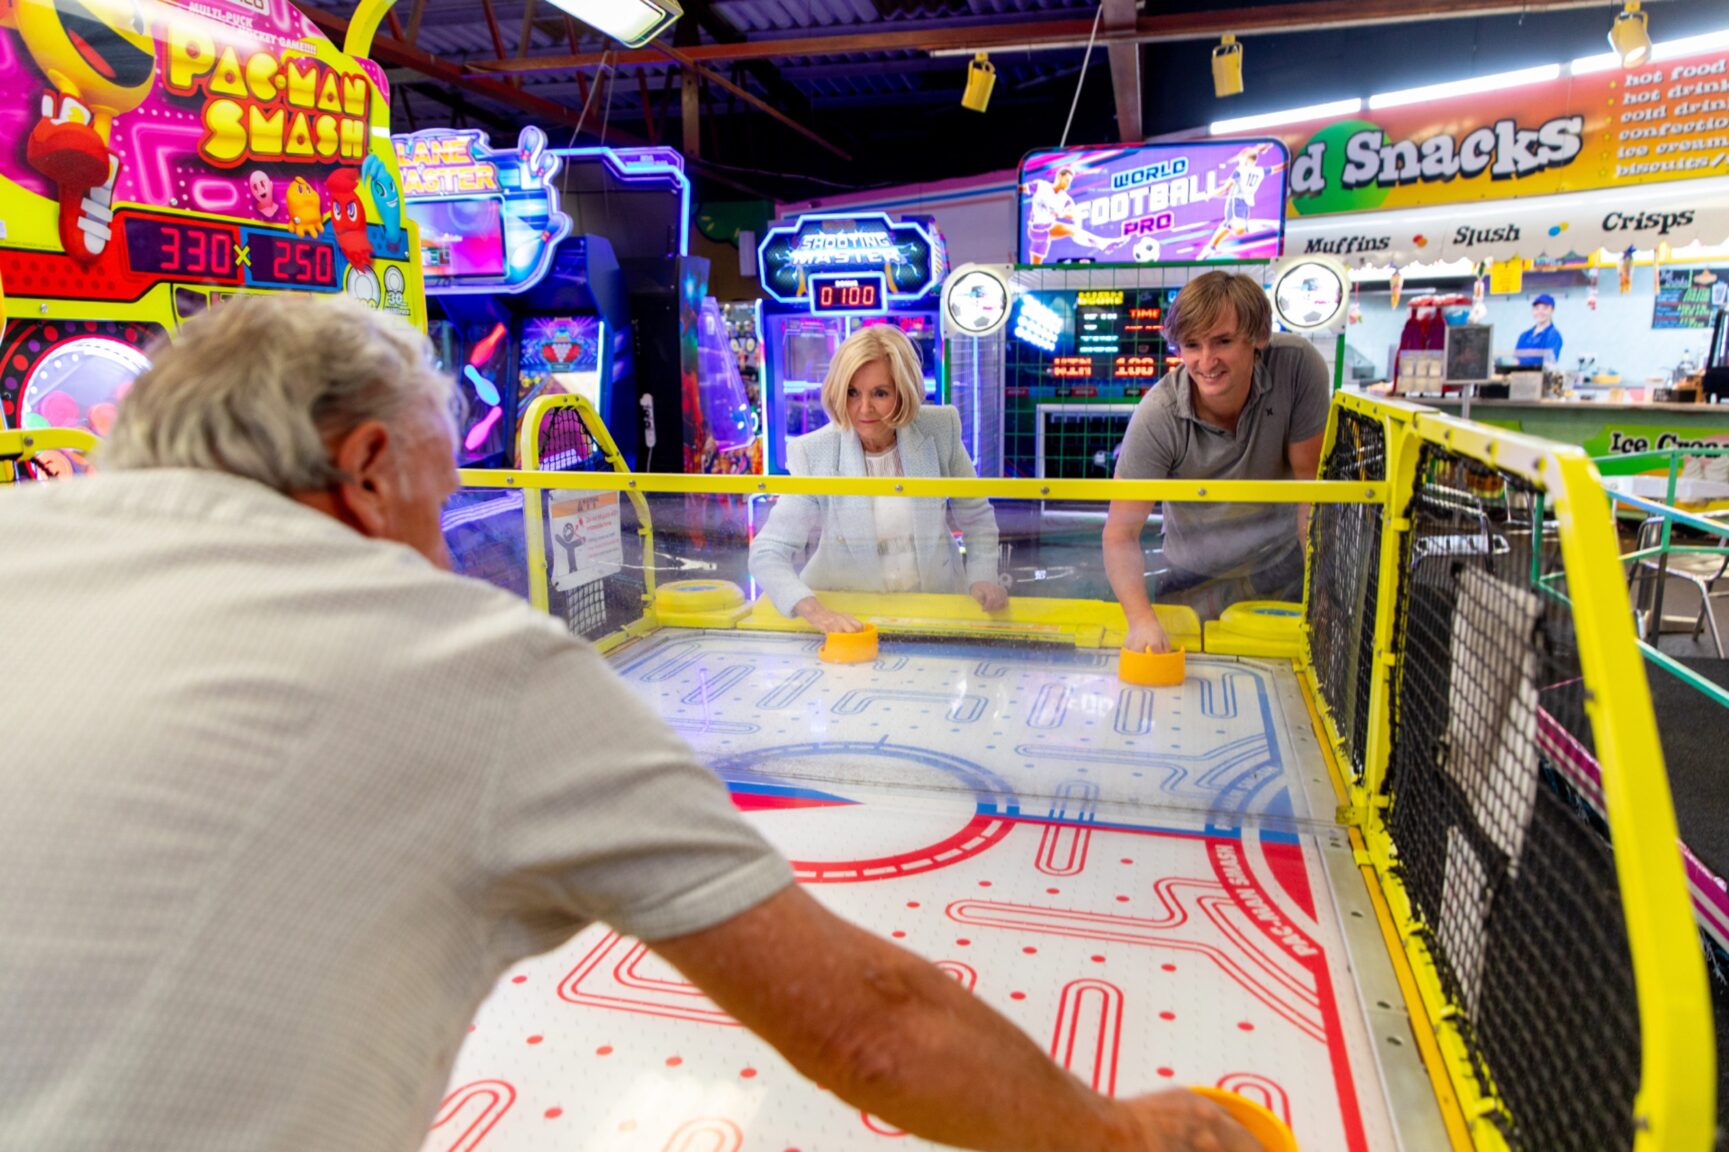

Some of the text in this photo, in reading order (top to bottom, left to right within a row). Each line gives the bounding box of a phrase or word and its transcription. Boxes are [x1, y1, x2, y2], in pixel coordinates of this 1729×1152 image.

[1624, 59, 1727, 87] hot food
[1622, 90, 1661, 105] hot
[1621, 99, 1729, 123] cold drin
[204, 98, 365, 160] SMASH
[395, 138, 473, 166] LANE
[1342, 116, 1584, 188] Snacks
[1617, 146, 1649, 159] ice
[402, 165, 497, 194] ASTER
[1112, 158, 1187, 189] WORLD
[1076, 170, 1220, 226] FOOTBALL
[1122, 213, 1173, 237] PRO
[1453, 223, 1520, 246] Slush
[1602, 209, 1695, 236] Crisps
[800, 232, 891, 249] SHOOTING
[1304, 234, 1390, 255] Muffins
[160, 227, 231, 274] 330
[273, 241, 332, 283] 250
[791, 248, 901, 265] MASTER
[1129, 308, 1161, 319] TIME
[1053, 357, 1092, 377] WIN
[1114, 357, 1155, 377] 100
[1611, 432, 1649, 454] Ice
[1236, 888, 1319, 957] PAC-MAN
